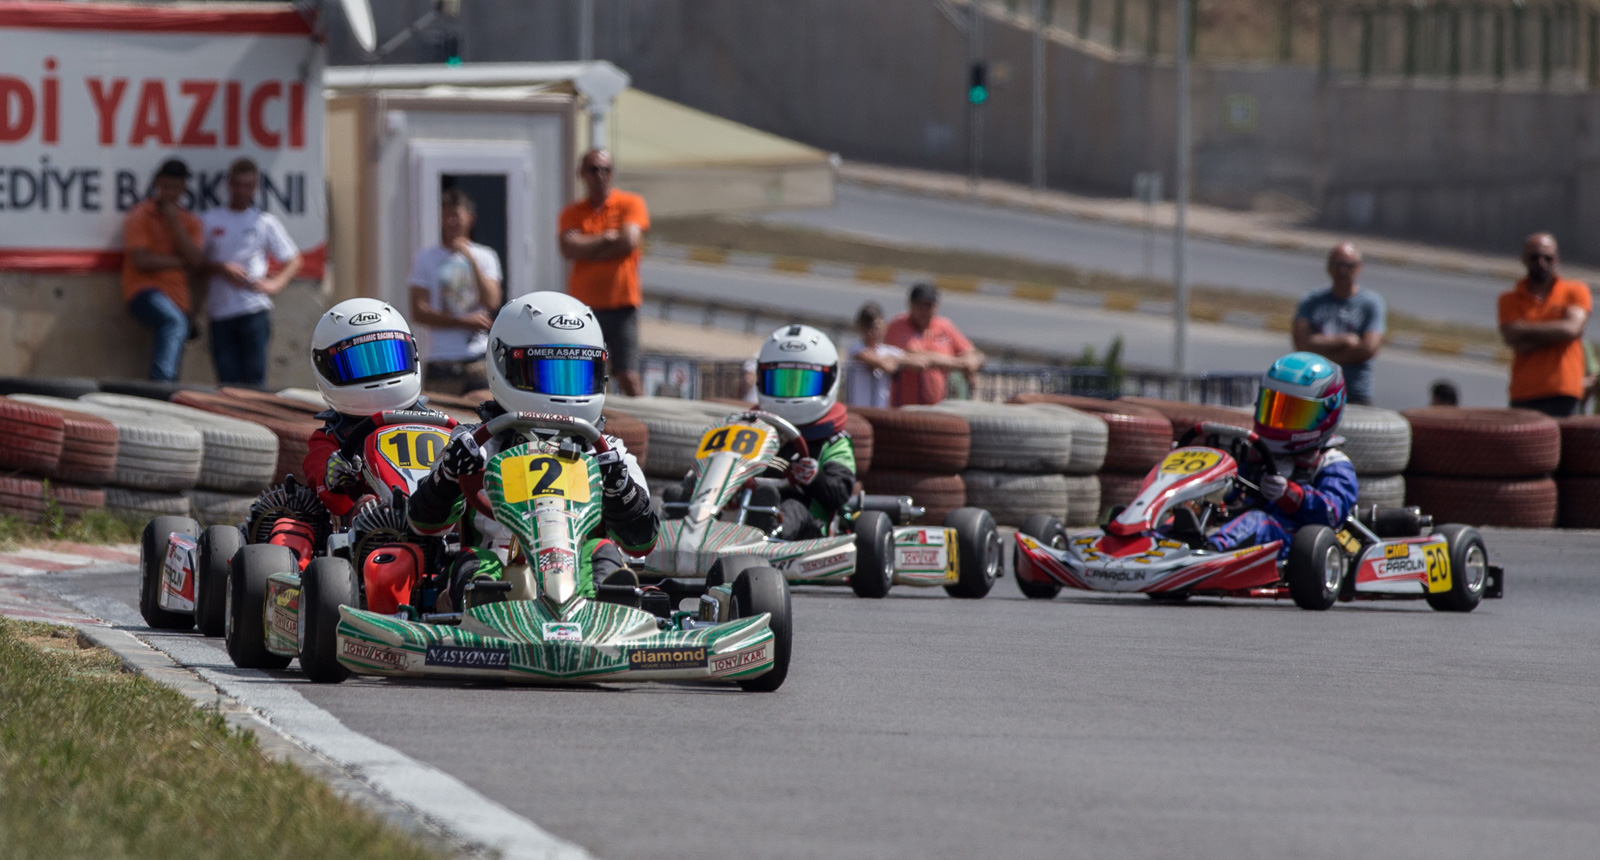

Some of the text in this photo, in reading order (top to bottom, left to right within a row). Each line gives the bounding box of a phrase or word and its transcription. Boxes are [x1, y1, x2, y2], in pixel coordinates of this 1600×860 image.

[85, 77, 307, 149] YAZICI
[353, 312, 380, 323] Arai
[553, 315, 582, 327] Arai
[352, 334, 376, 345] DYNAMIC
[376, 331, 394, 340] RACING
[527, 348, 554, 356] ÖMER
[556, 348, 580, 356] ASAF
[703, 427, 760, 456] 48
[388, 432, 446, 467] 10
[1164, 458, 1206, 472] 20
[529, 457, 565, 497] 2
[1427, 547, 1448, 582] 20
[426, 648, 508, 666] NASYONEL
[631, 648, 705, 663] diamond
[713, 656, 737, 670] TONY
